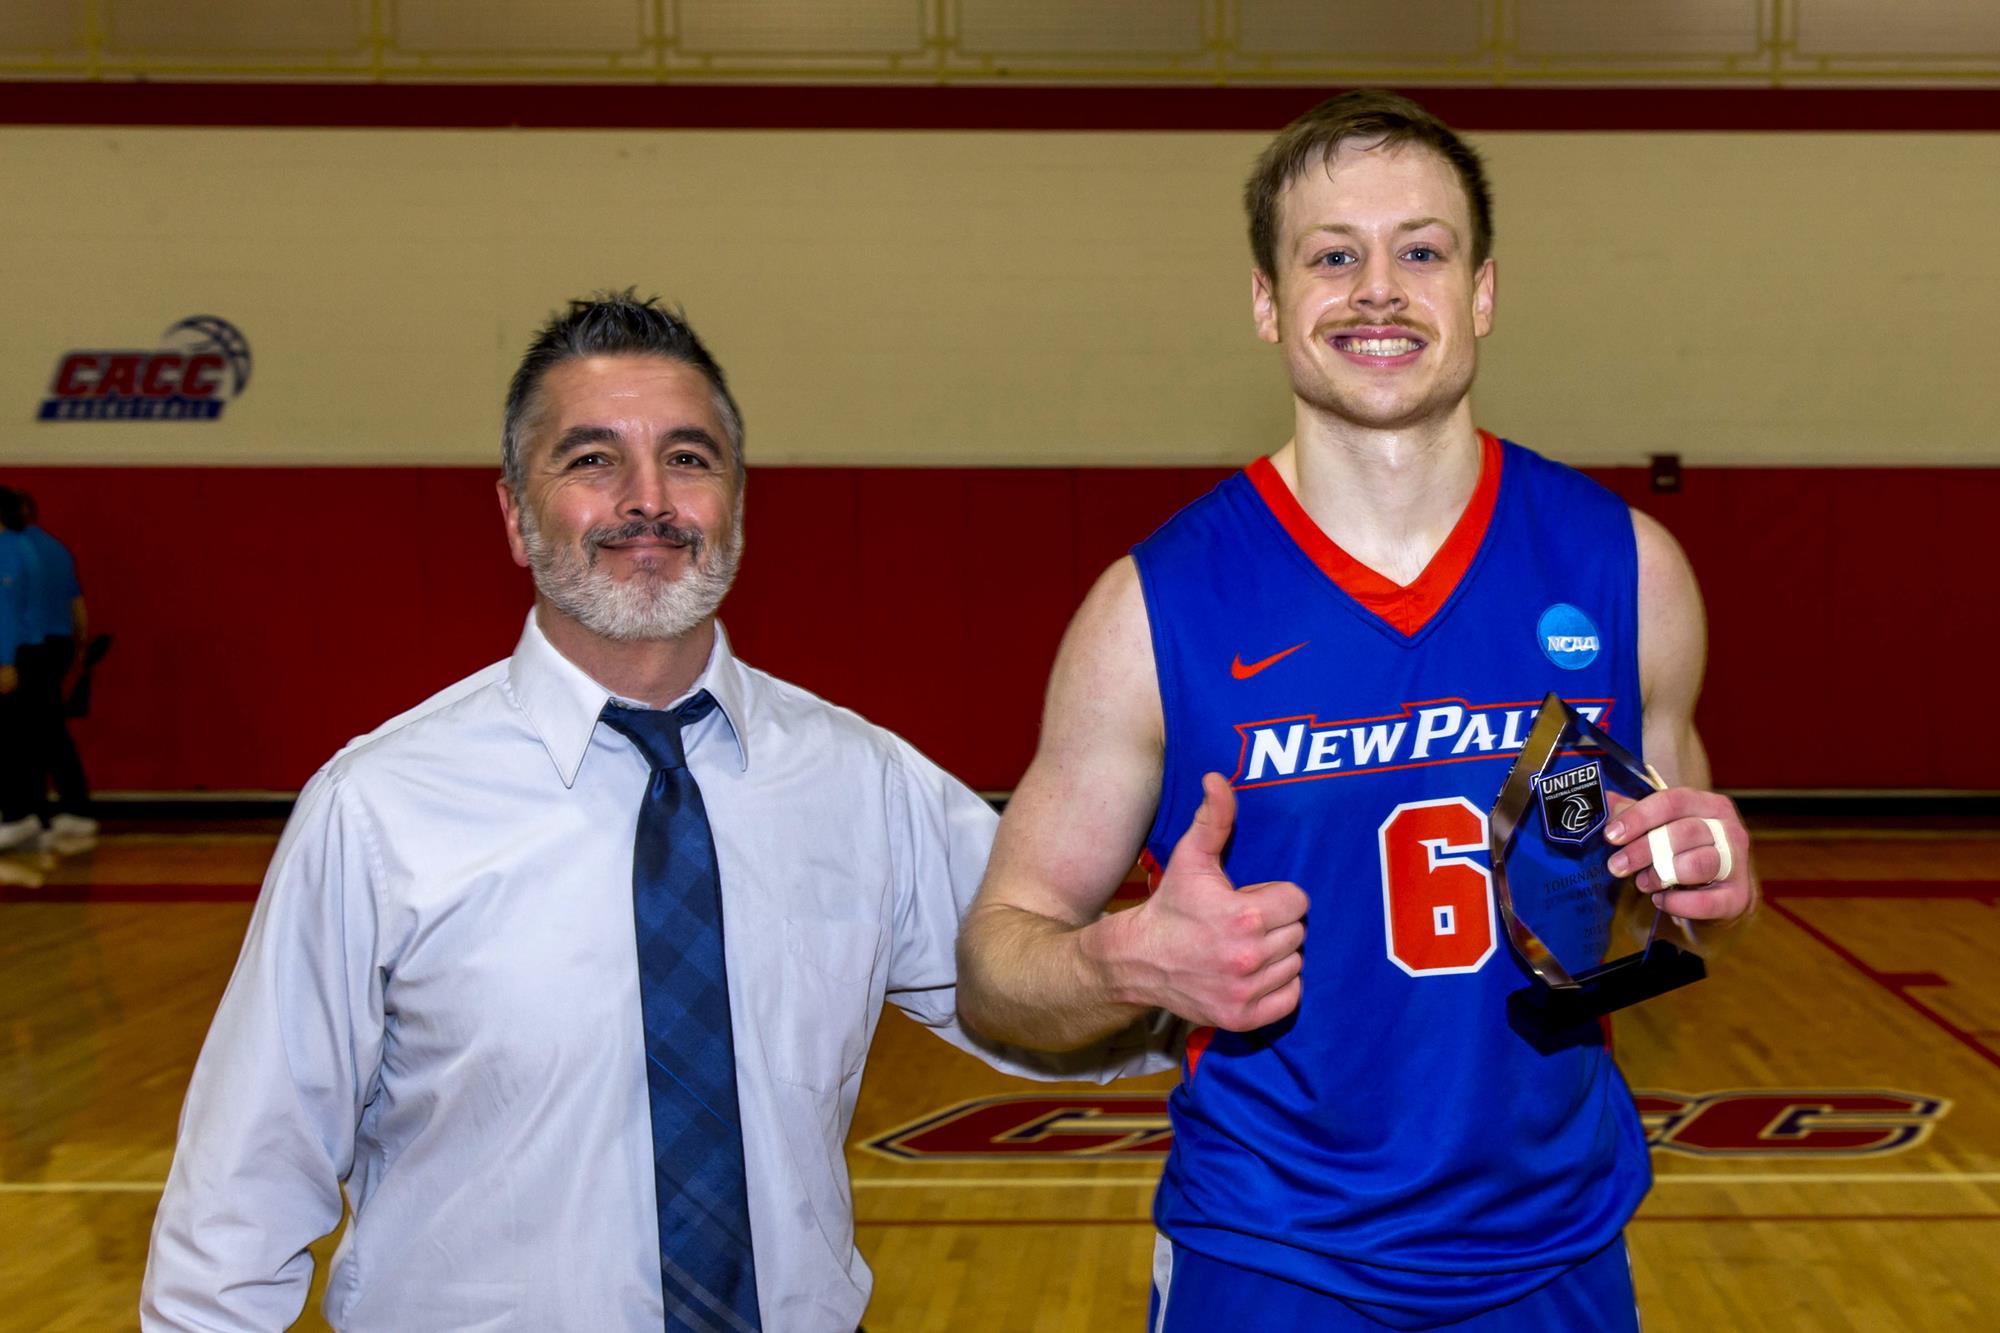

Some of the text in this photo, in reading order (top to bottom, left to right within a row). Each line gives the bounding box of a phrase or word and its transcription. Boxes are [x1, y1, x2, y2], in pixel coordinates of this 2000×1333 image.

[53, 350, 225, 398] CACC
[1547, 635, 1599, 652] NCAA
[1245, 706, 1602, 780] NEW PAL
[1542, 766, 1597, 794] UNITED
[1377, 796, 1498, 977] 6
